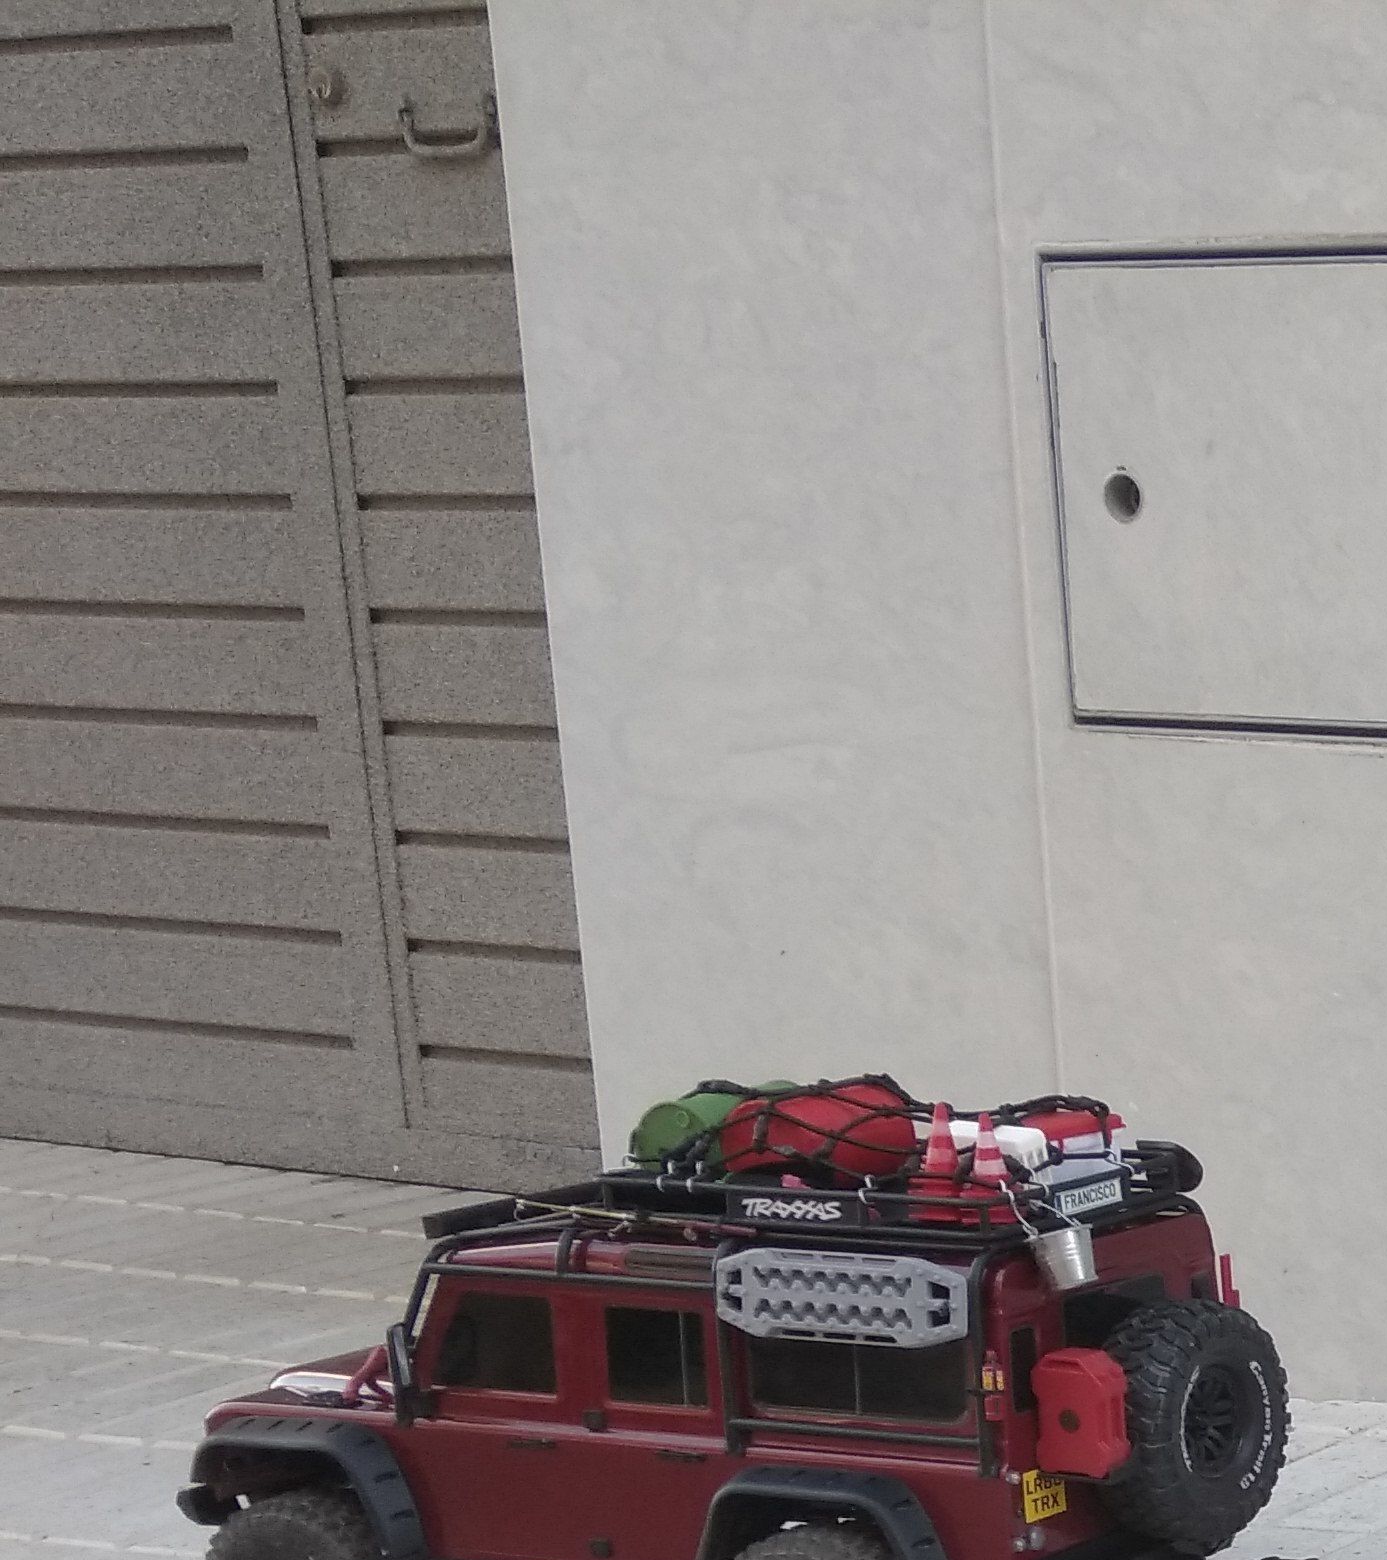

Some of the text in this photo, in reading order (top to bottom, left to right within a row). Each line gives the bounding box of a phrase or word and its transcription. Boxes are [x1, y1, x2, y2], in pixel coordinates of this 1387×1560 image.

[1064, 1182, 1116, 1209] FRANCISCO
[741, 1198, 842, 1221] TRAXXAS
[1032, 1493, 1060, 1513] TRX
